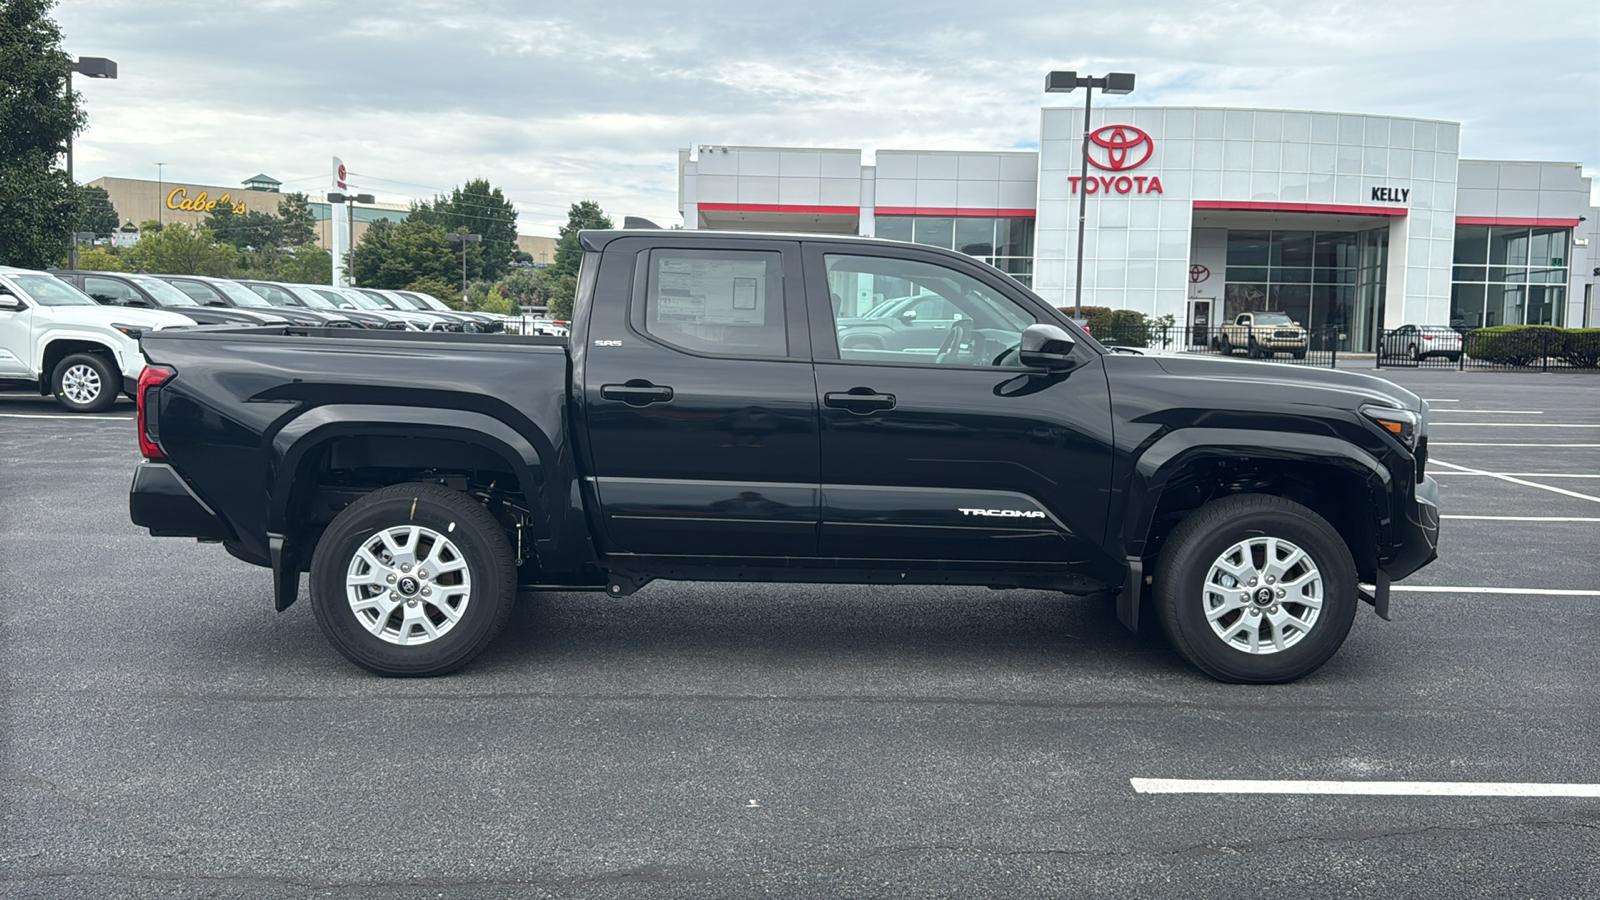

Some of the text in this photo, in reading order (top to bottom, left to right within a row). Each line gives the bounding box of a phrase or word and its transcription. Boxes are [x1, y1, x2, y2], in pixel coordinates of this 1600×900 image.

[1067, 175, 1164, 194] TOYOTA
[1372, 187, 1410, 203] KELLY
[957, 507, 1046, 519] TACOMA
